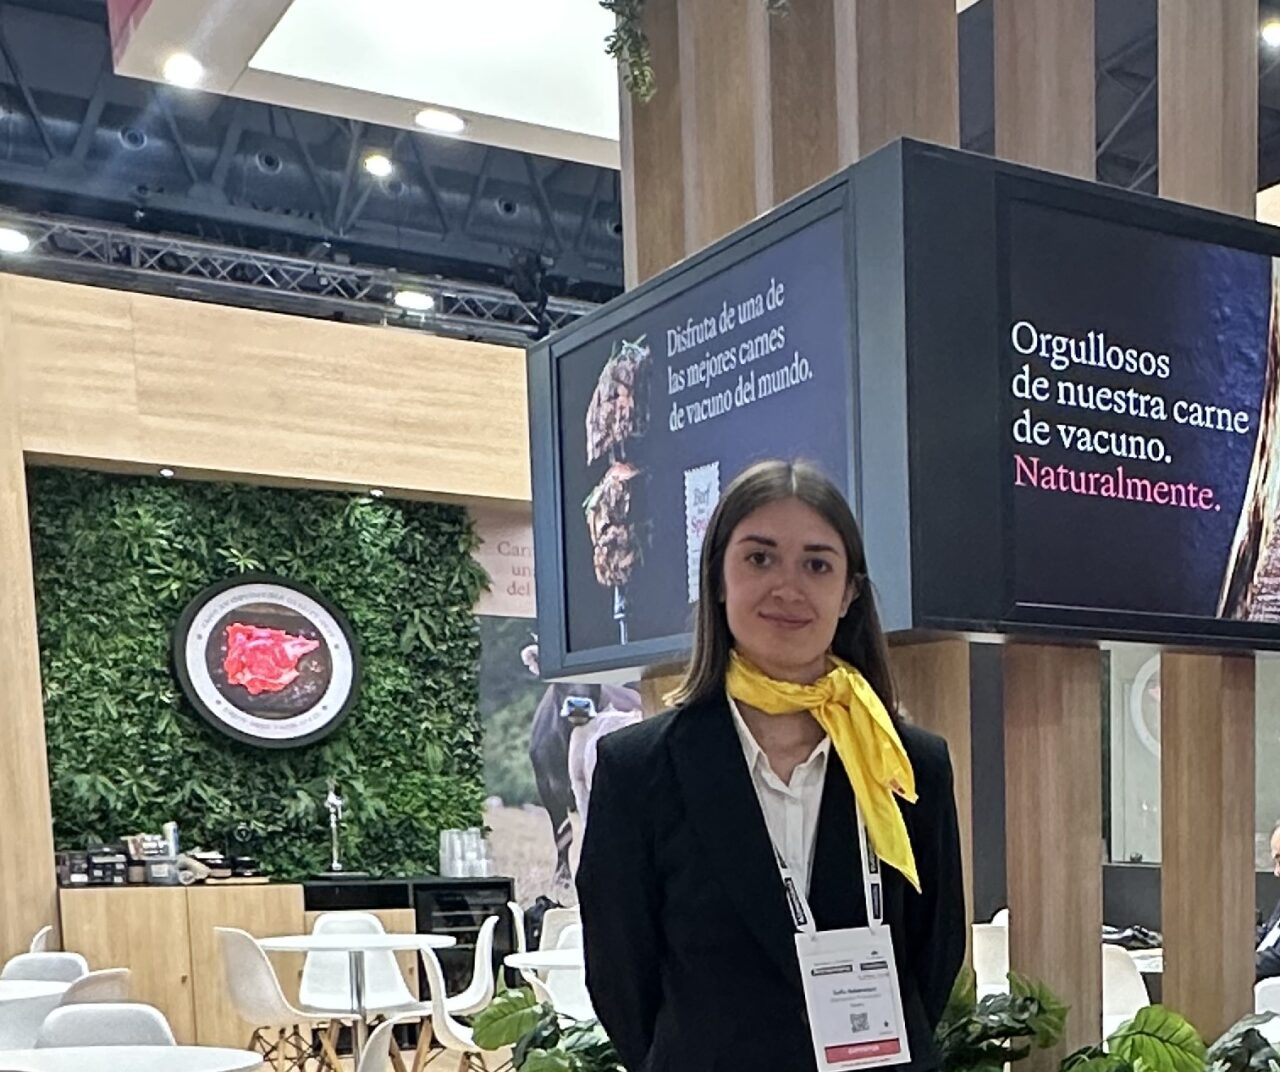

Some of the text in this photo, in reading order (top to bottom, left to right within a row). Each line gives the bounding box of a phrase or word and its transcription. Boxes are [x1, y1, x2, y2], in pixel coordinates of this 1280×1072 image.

[667, 277, 785, 357] Disfruta de una de
[667, 325, 786, 395] las mejores carnes
[1011, 321, 1170, 378] Orgullosos
[669, 351, 813, 432] de vacuno del mundo.
[1012, 364, 1249, 434] de nuestra carne
[1012, 409, 1172, 464] de vacuno.
[1014, 454, 1221, 512] Naturalmente.
[506, 581, 531, 596] del
